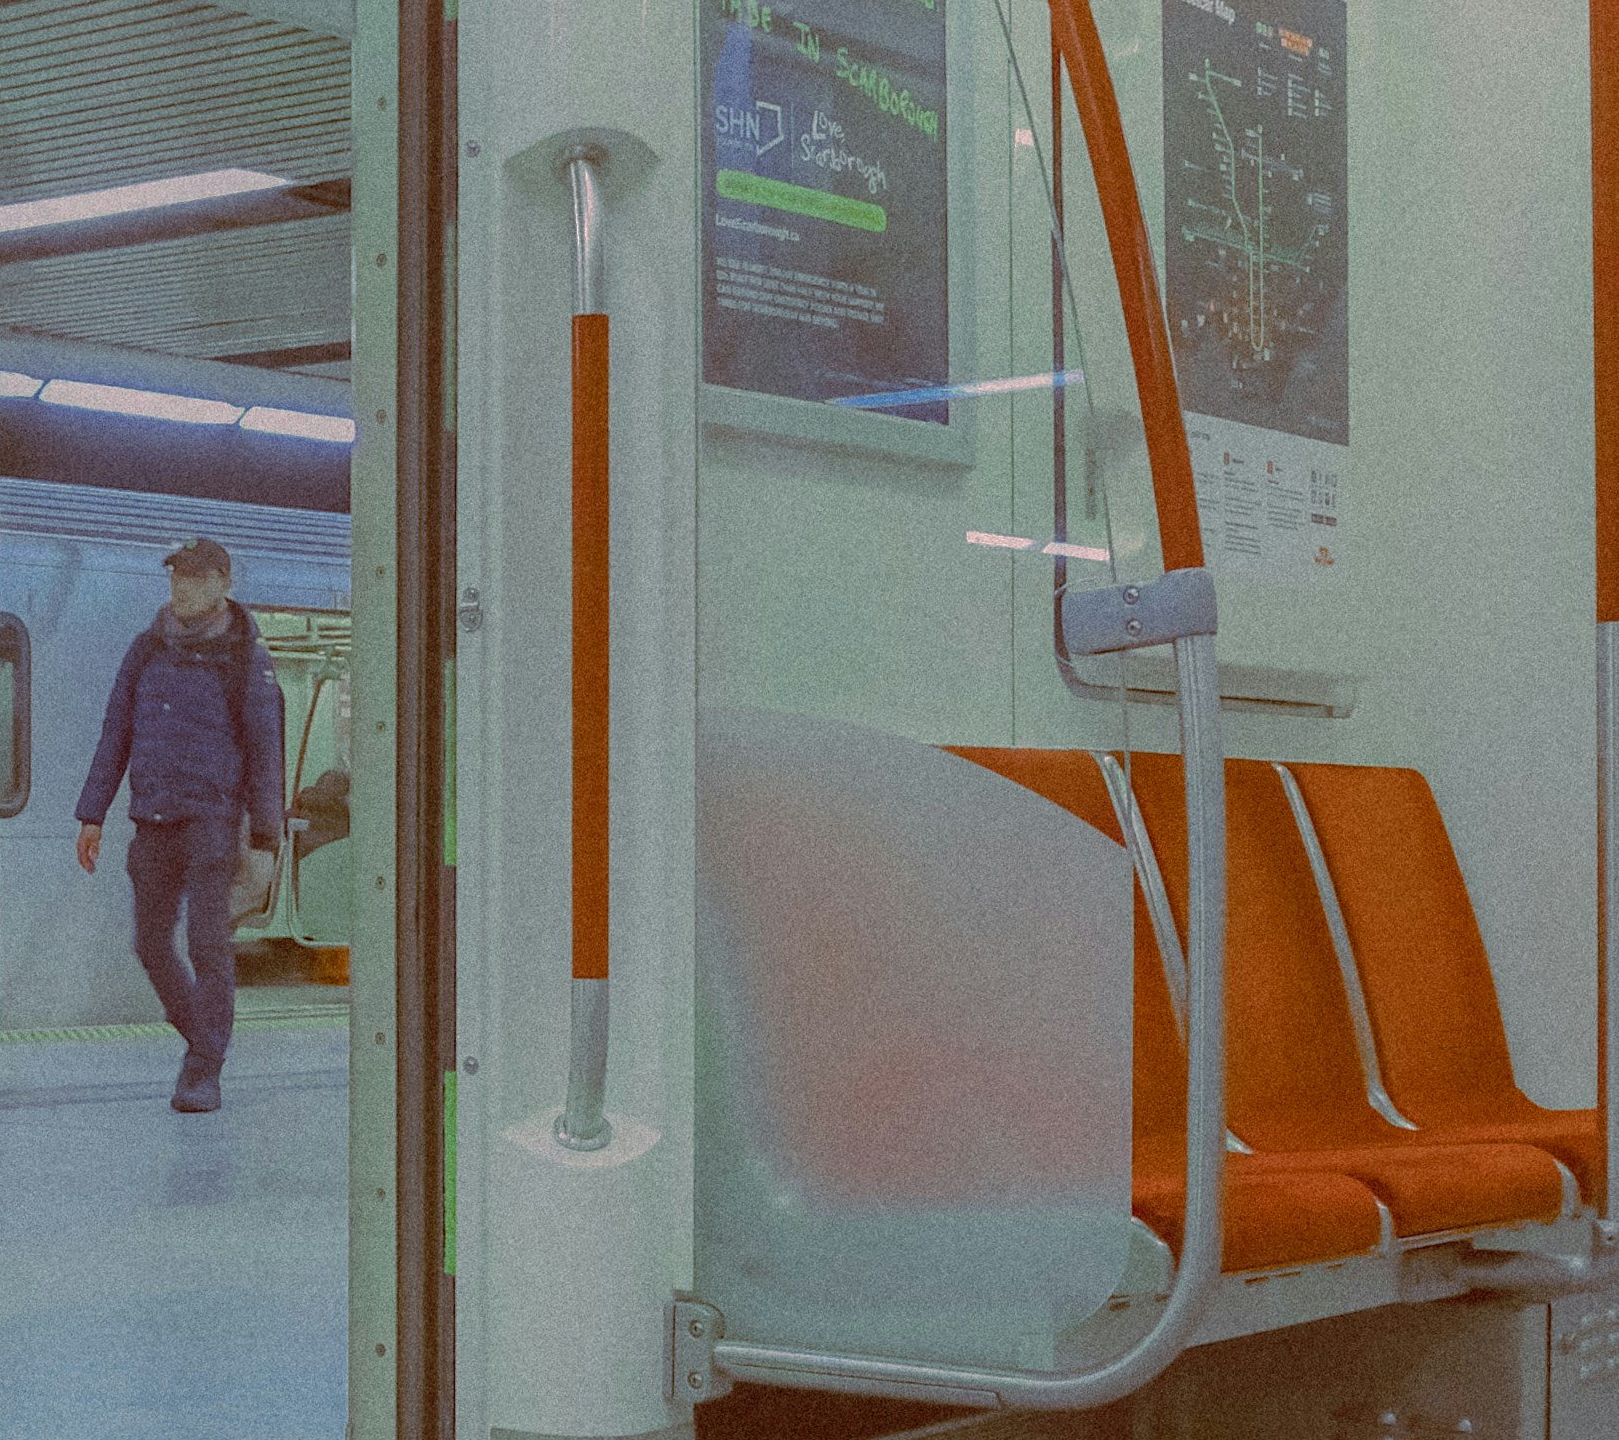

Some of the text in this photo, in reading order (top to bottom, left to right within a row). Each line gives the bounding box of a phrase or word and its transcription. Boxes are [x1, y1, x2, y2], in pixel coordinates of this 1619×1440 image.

[792, 21, 821, 63] IN
[836, 47, 939, 142] SCARBOROUGH
[715, 104, 760, 141] SHN
